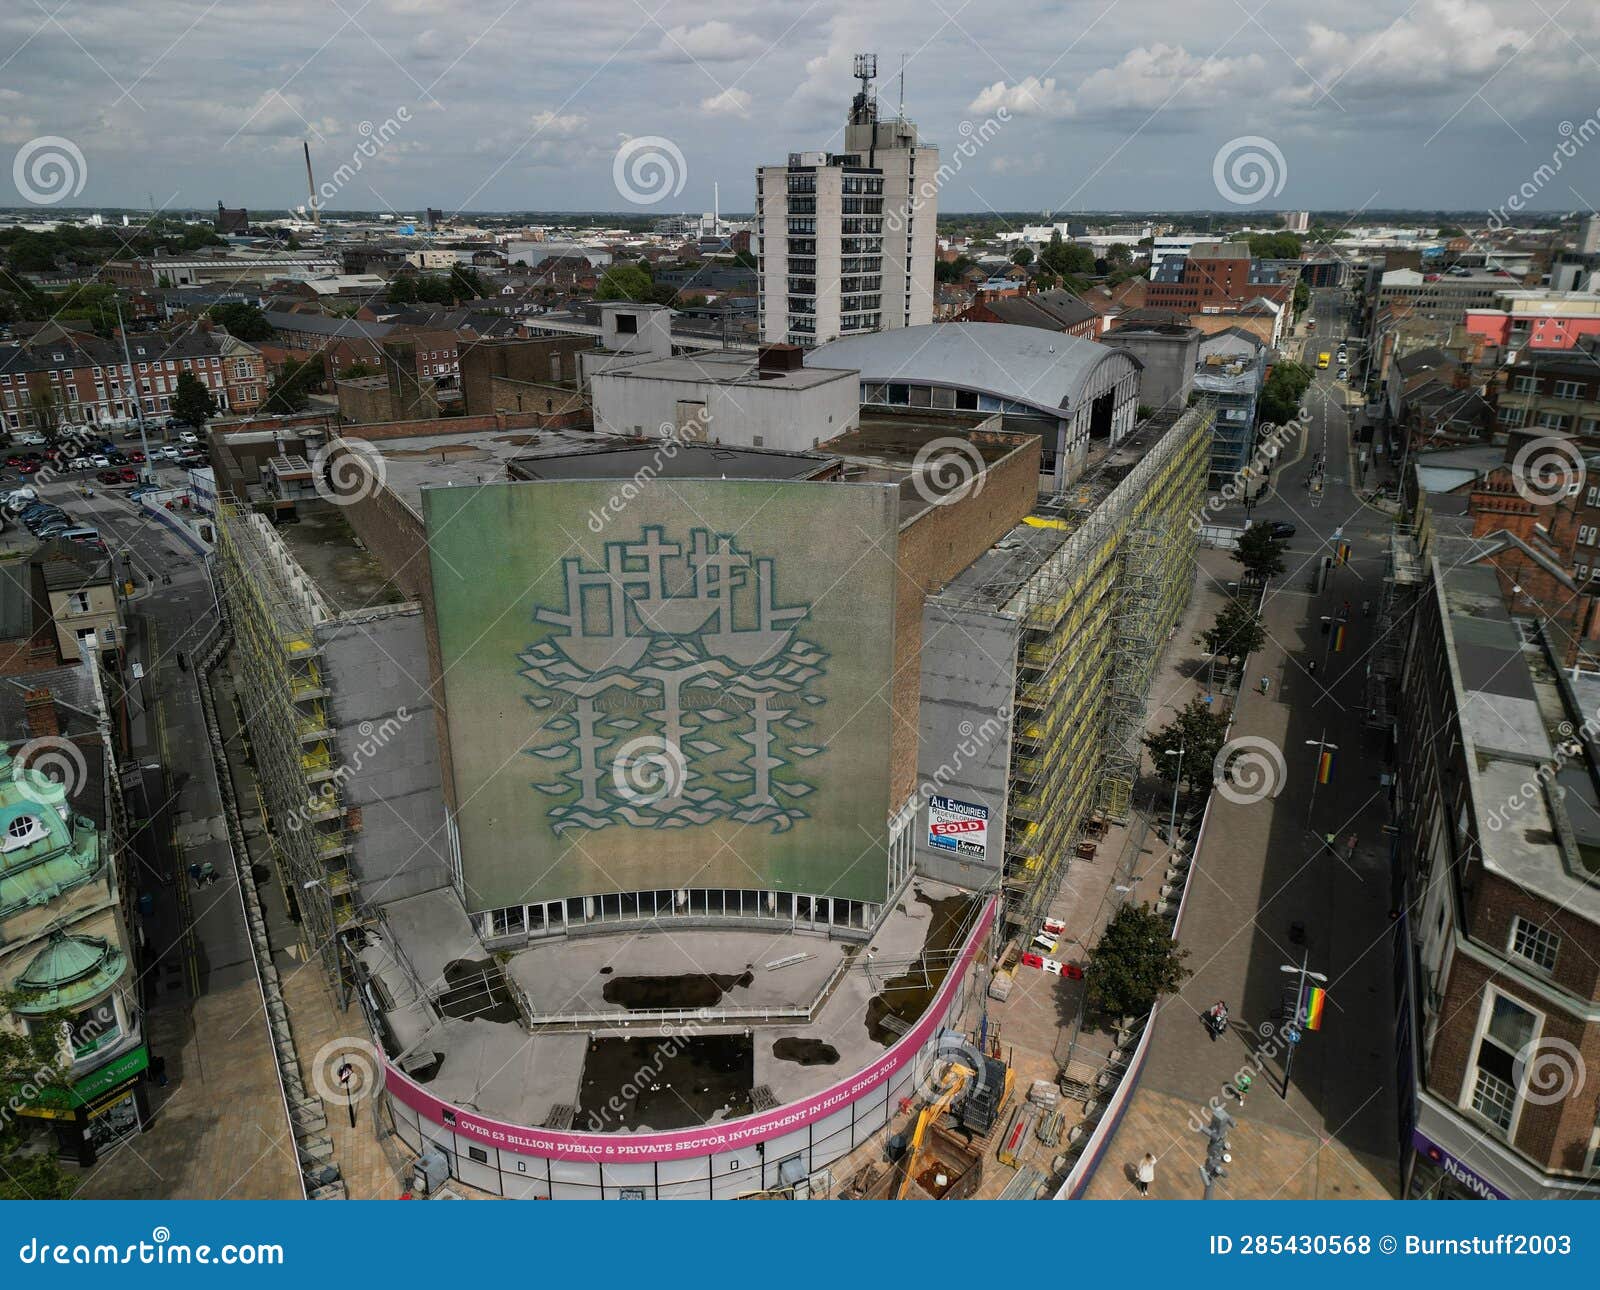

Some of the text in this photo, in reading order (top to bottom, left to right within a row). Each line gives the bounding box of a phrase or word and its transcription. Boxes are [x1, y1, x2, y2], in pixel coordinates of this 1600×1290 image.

[936, 822, 979, 833] SOLD
[461, 1057, 898, 1155] OVER £3 BILLION PUBLIC & PRIVATE SECTOR INVESTMENT IN HULL SINCE 2013
